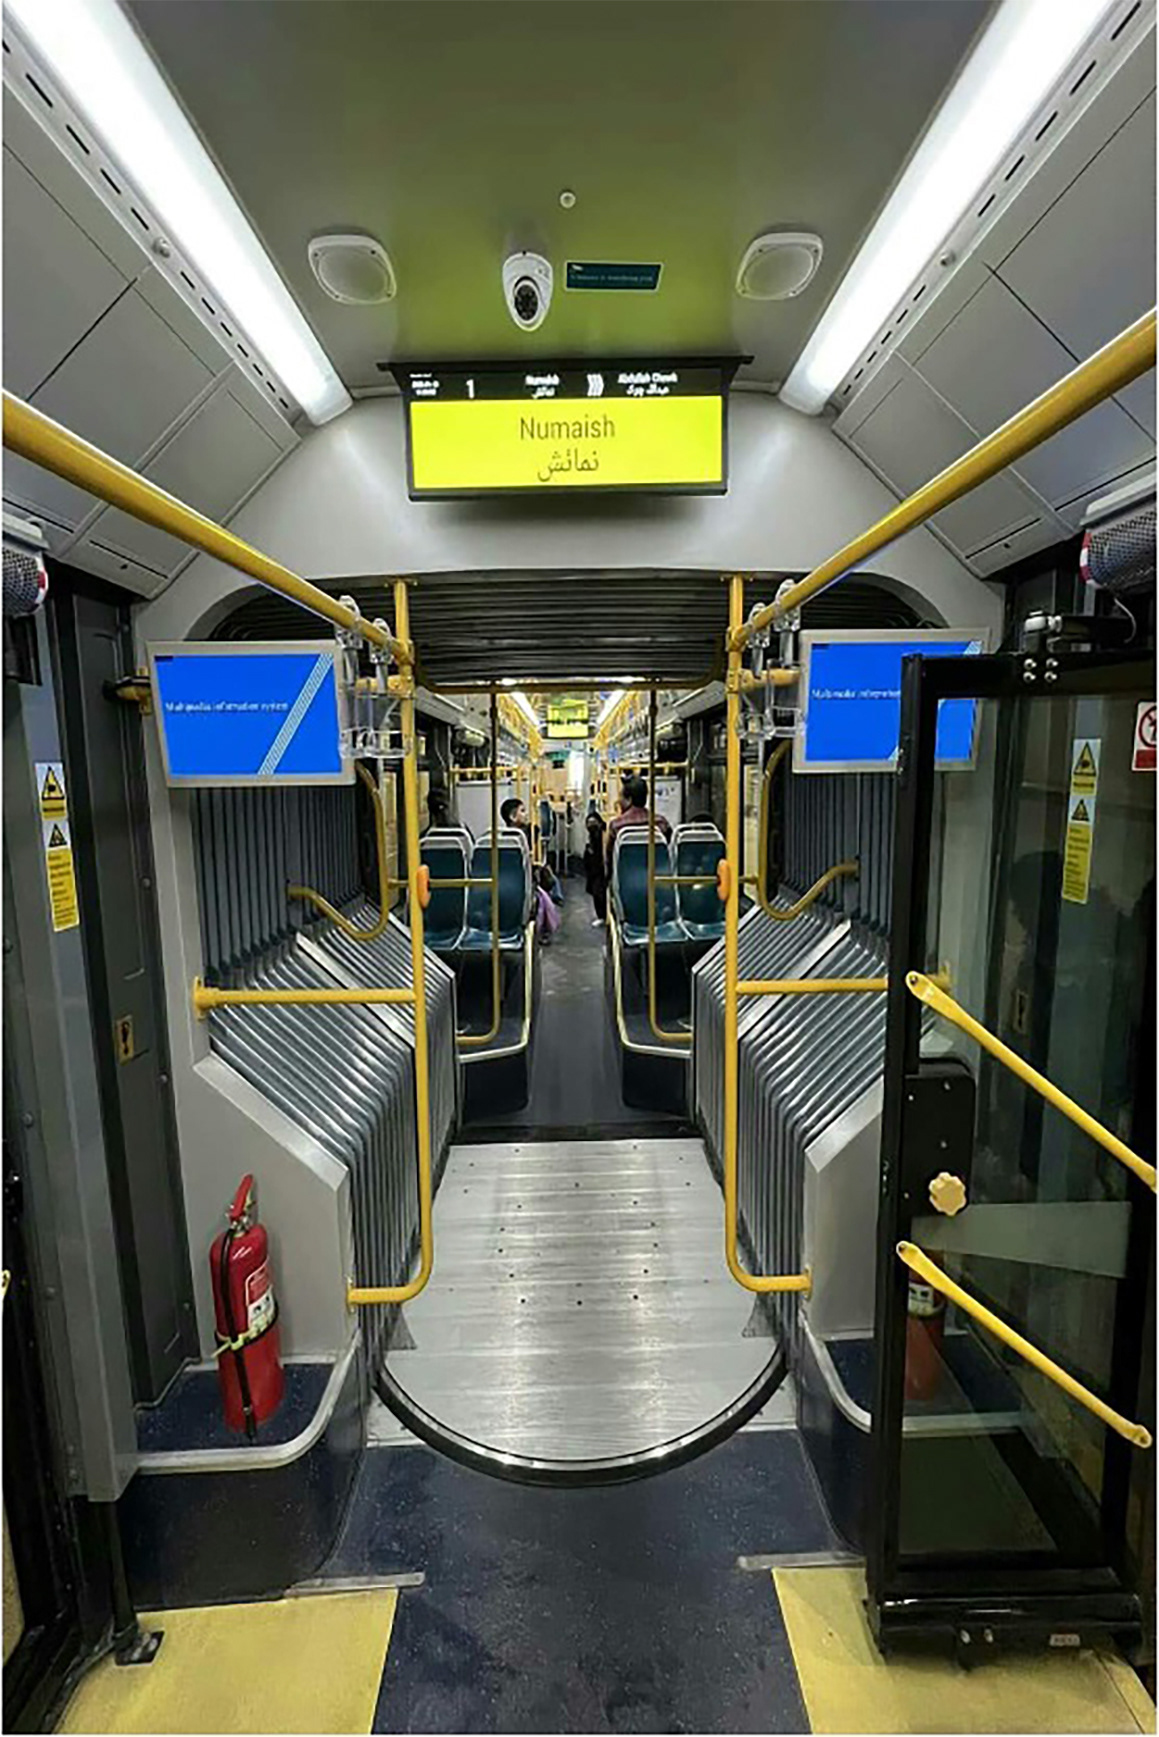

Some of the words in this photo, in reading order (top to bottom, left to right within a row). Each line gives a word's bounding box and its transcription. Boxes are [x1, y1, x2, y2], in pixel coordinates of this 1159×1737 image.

[465, 379, 475, 399] 1
[525, 373, 560, 386] Numaish
[520, 414, 616, 440] Numaish
[536, 448, 600, 483] نمائش
